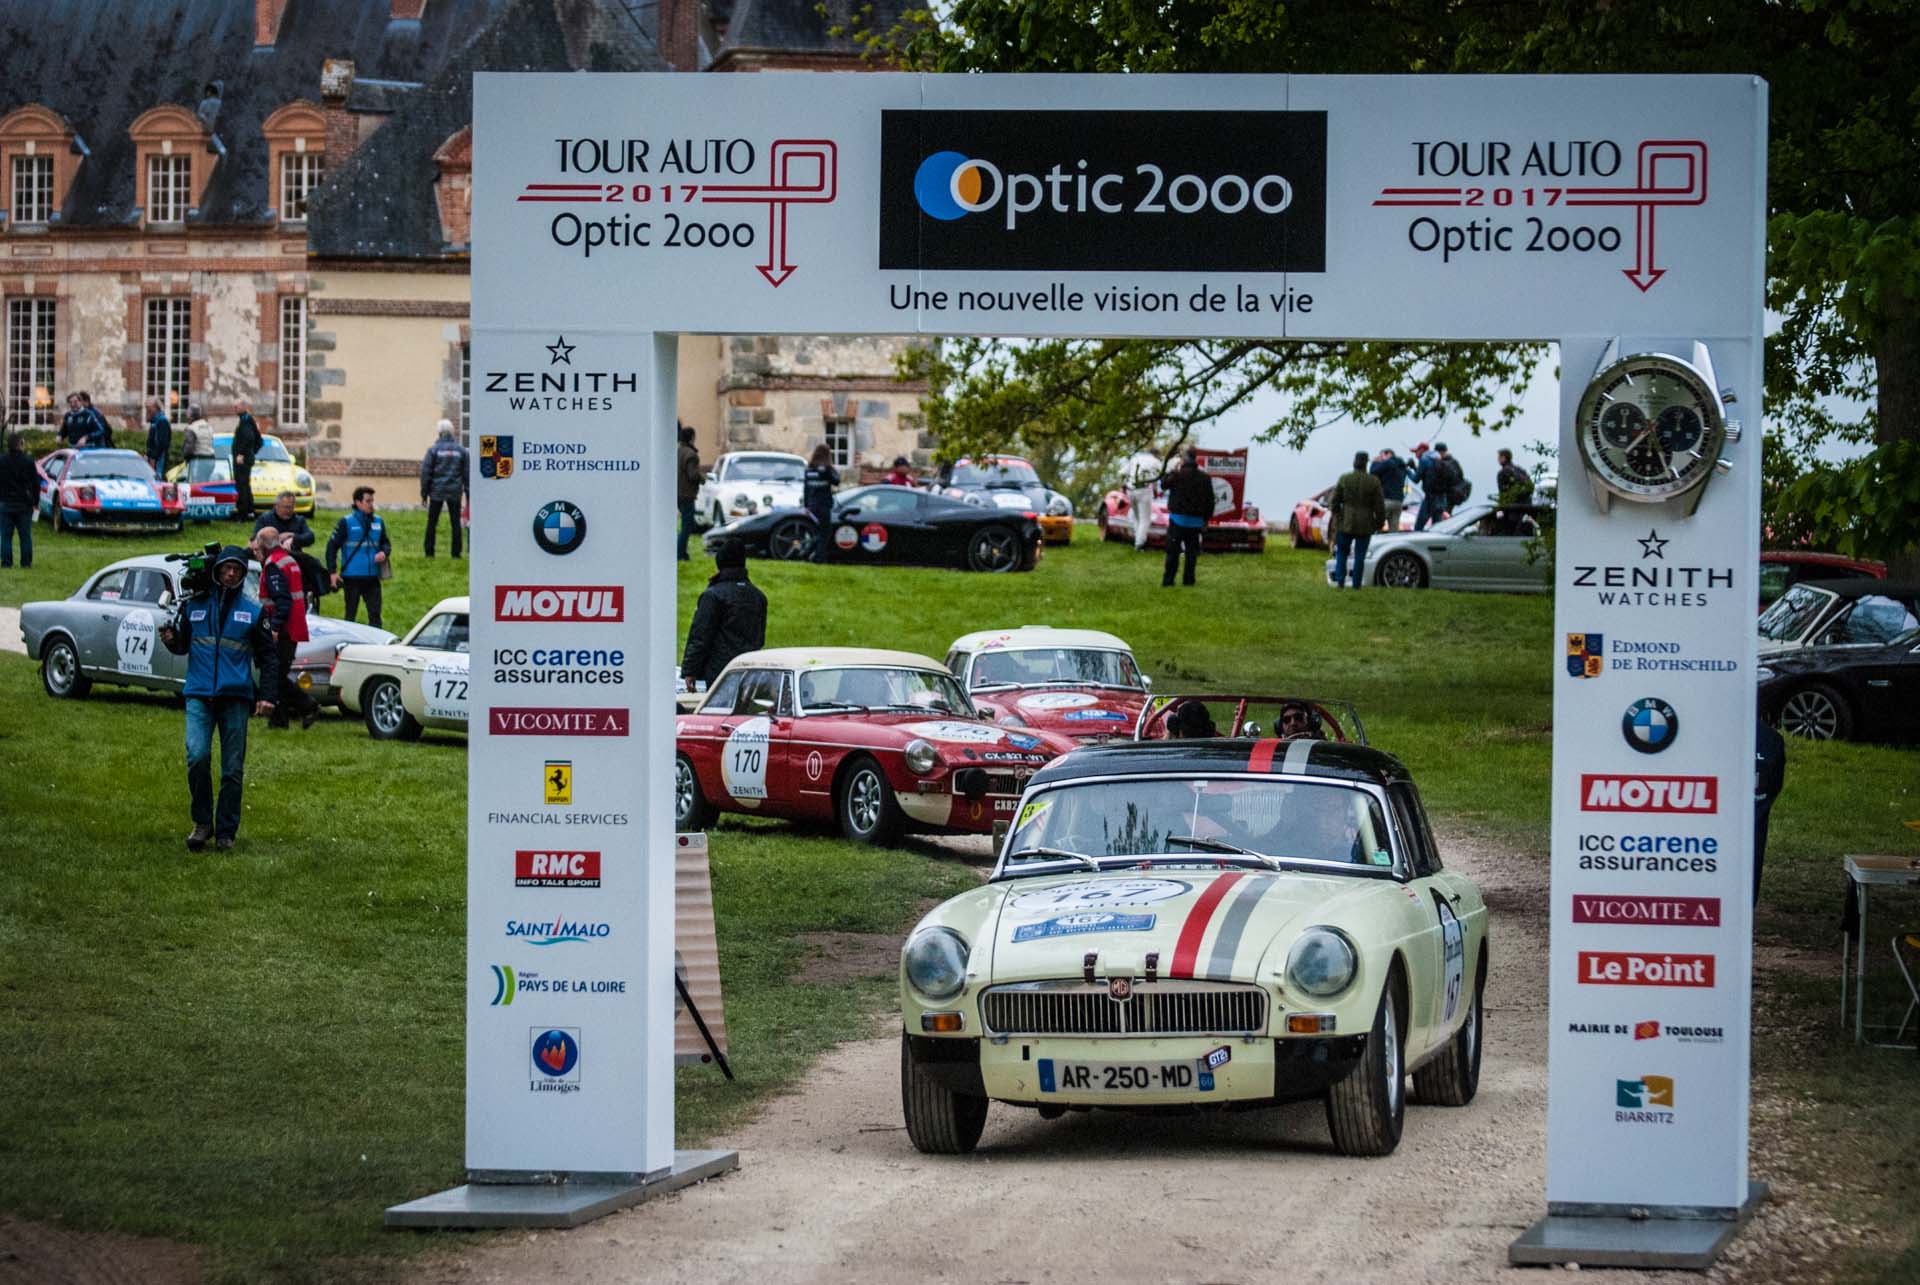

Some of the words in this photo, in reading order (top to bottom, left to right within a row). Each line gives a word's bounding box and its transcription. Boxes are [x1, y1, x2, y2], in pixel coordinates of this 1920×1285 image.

[555, 138, 650, 174] TOUR
[660, 138, 756, 174] AUTO
[1411, 140, 1511, 177] TOUR
[1521, 140, 1622, 177] AUTO
[605, 184, 700, 203] 2017
[949, 158, 1124, 230] Optic
[1464, 187, 1563, 207] 2017
[551, 212, 651, 258] Optic
[1408, 216, 1513, 262] Optic
[889, 284, 949, 311] Une
[958, 284, 1084, 312] nouvelle
[1093, 285, 1179, 312] vision
[1189, 284, 1227, 313] de
[1237, 284, 1261, 313] la
[1269, 286, 1314, 313] vie
[485, 372, 637, 393] ZENITH
[509, 397, 613, 411] WATCHES
[522, 441, 587, 455] EDMOND
[522, 460, 541, 471] DE
[546, 458, 640, 472] ROTHSCHILD
[538, 502, 583, 520] BMW
[1573, 566, 1734, 588] ZENITH
[500, 590, 619, 617] MOTUL
[1598, 592, 1708, 606] WATCHES
[125, 635, 148, 656] 174
[1612, 640, 1680, 654] EDMOND
[493, 649, 528, 665] ICC
[532, 649, 625, 667] carene
[1612, 658, 1633, 670] DE
[1636, 657, 1738, 672] ROTHSCHILD
[494, 669, 625, 685] assurances
[434, 679, 469, 700] 172
[1627, 700, 1674, 718] BMW
[496, 712, 597, 731] VICOMTE
[735, 749, 761, 774] 170
[733, 785, 763, 796] ZENITH
[1586, 779, 1713, 809] MOTUL
[994, 800, 1020, 811] CX82
[488, 812, 561, 825] FINANCIAL
[565, 813, 629, 826] SERVICES
[1578, 834, 1615, 851] ICC
[1620, 835, 1718, 854] carene
[531, 853, 586, 876] RMC
[1579, 855, 1718, 873] assurances
[516, 878, 539, 887] INFO
[541, 879, 566, 887] TALK
[567, 879, 601, 888] SPORT
[1580, 900, 1687, 921] VICOMTE
[1587, 956, 1622, 980] Le
[1626, 955, 1706, 983] Point
[518, 980, 549, 992] PAYS
[552, 980, 569, 992] DE
[572, 980, 588, 993] LA
[591, 981, 626, 993] LOIRE
[1568, 1023, 1610, 1034] MAIRIE
[1614, 1024, 1629, 1034] DE
[1664, 1026, 1724, 1037] TOULOUSE
[1062, 1064, 1192, 1089] AR-250-MD
[530, 1080, 580, 1094] Limoges
[1615, 1111, 1675, 1124] BIARRITZ
